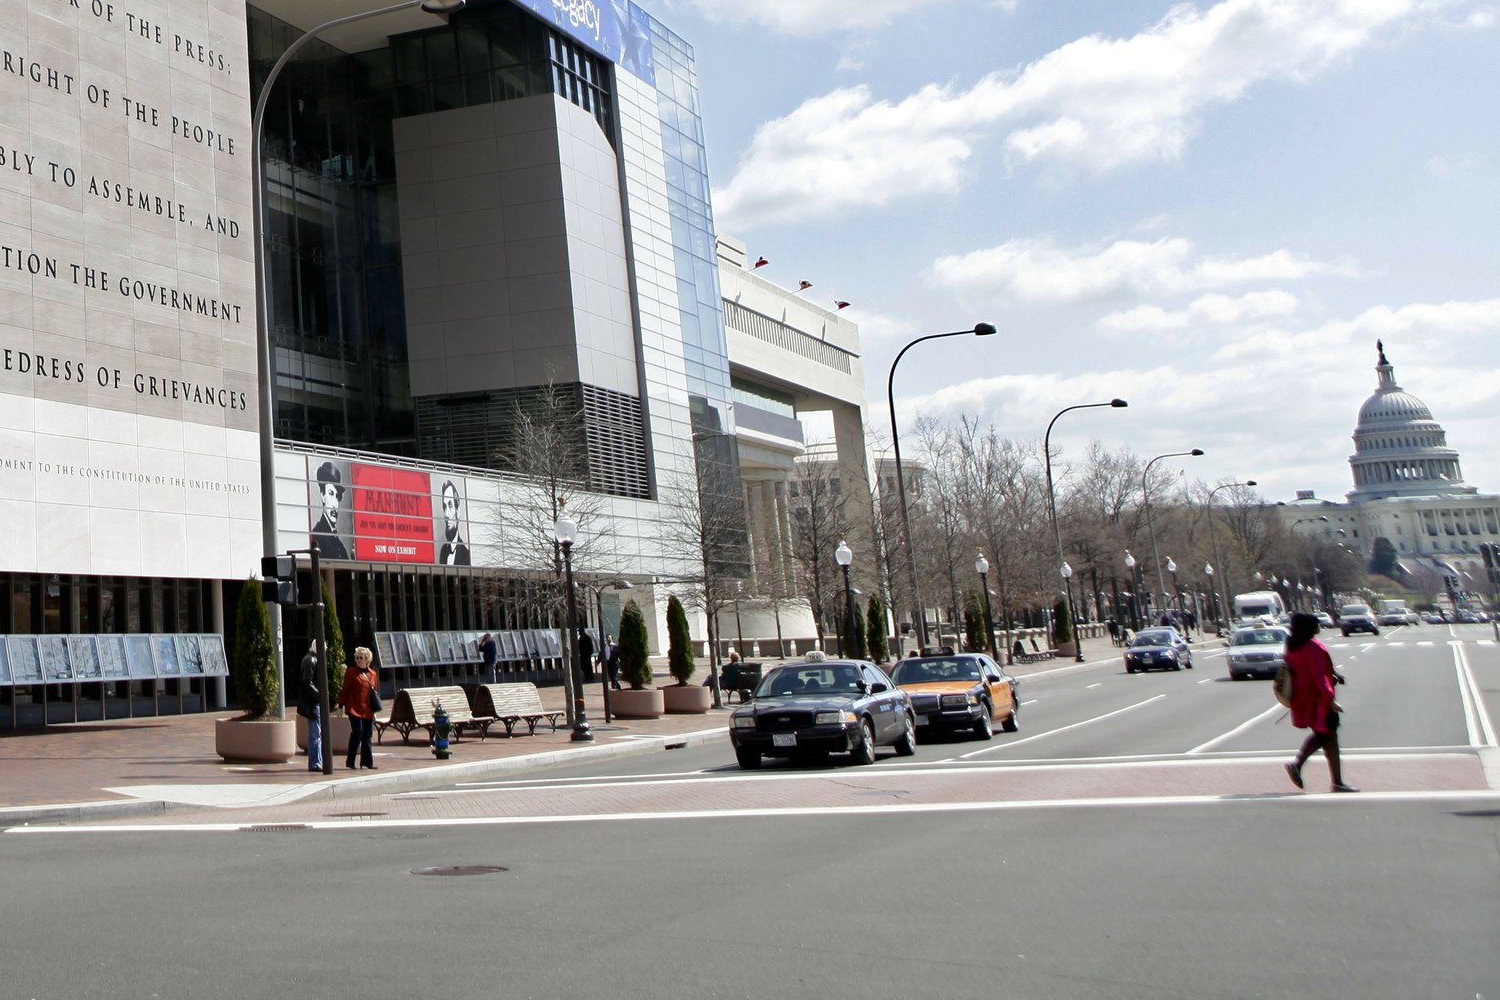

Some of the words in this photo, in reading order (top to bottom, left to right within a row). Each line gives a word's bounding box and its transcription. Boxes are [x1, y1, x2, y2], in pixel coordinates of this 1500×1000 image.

[92, 0, 113, 22] OF
[126, 13, 162, 44] THE
[174, 36, 231, 75] PRESS;
[4, 51, 74, 95] RIGHT
[87, 85, 110, 108] OF
[123, 98, 158, 127] THE
[172, 116, 235, 156] PEOPLE
[49, 162, 75, 187] TO
[89, 176, 192, 226] ASSEMBLE,
[205, 213, 240, 239] AND
[71, 265, 108, 291] THE
[119, 277, 241, 323] GOVERNMENT
[97, 367, 121, 389] OF
[134, 374, 247, 411] GRIEVANCES
[39, 462, 50, 472] TO
[57, 465, 74, 475] THE
[80, 468, 150, 483] CONSTITUTION
[155, 476, 164, 485] OF
[170, 478, 185, 487] THE
[190, 480, 219, 491] UNITED
[224, 484, 250, 494] STATES
[375, 545, 387, 553] NOW
[388, 545, 396, 554] ON
[396, 546, 416, 555] EXHIBIT
